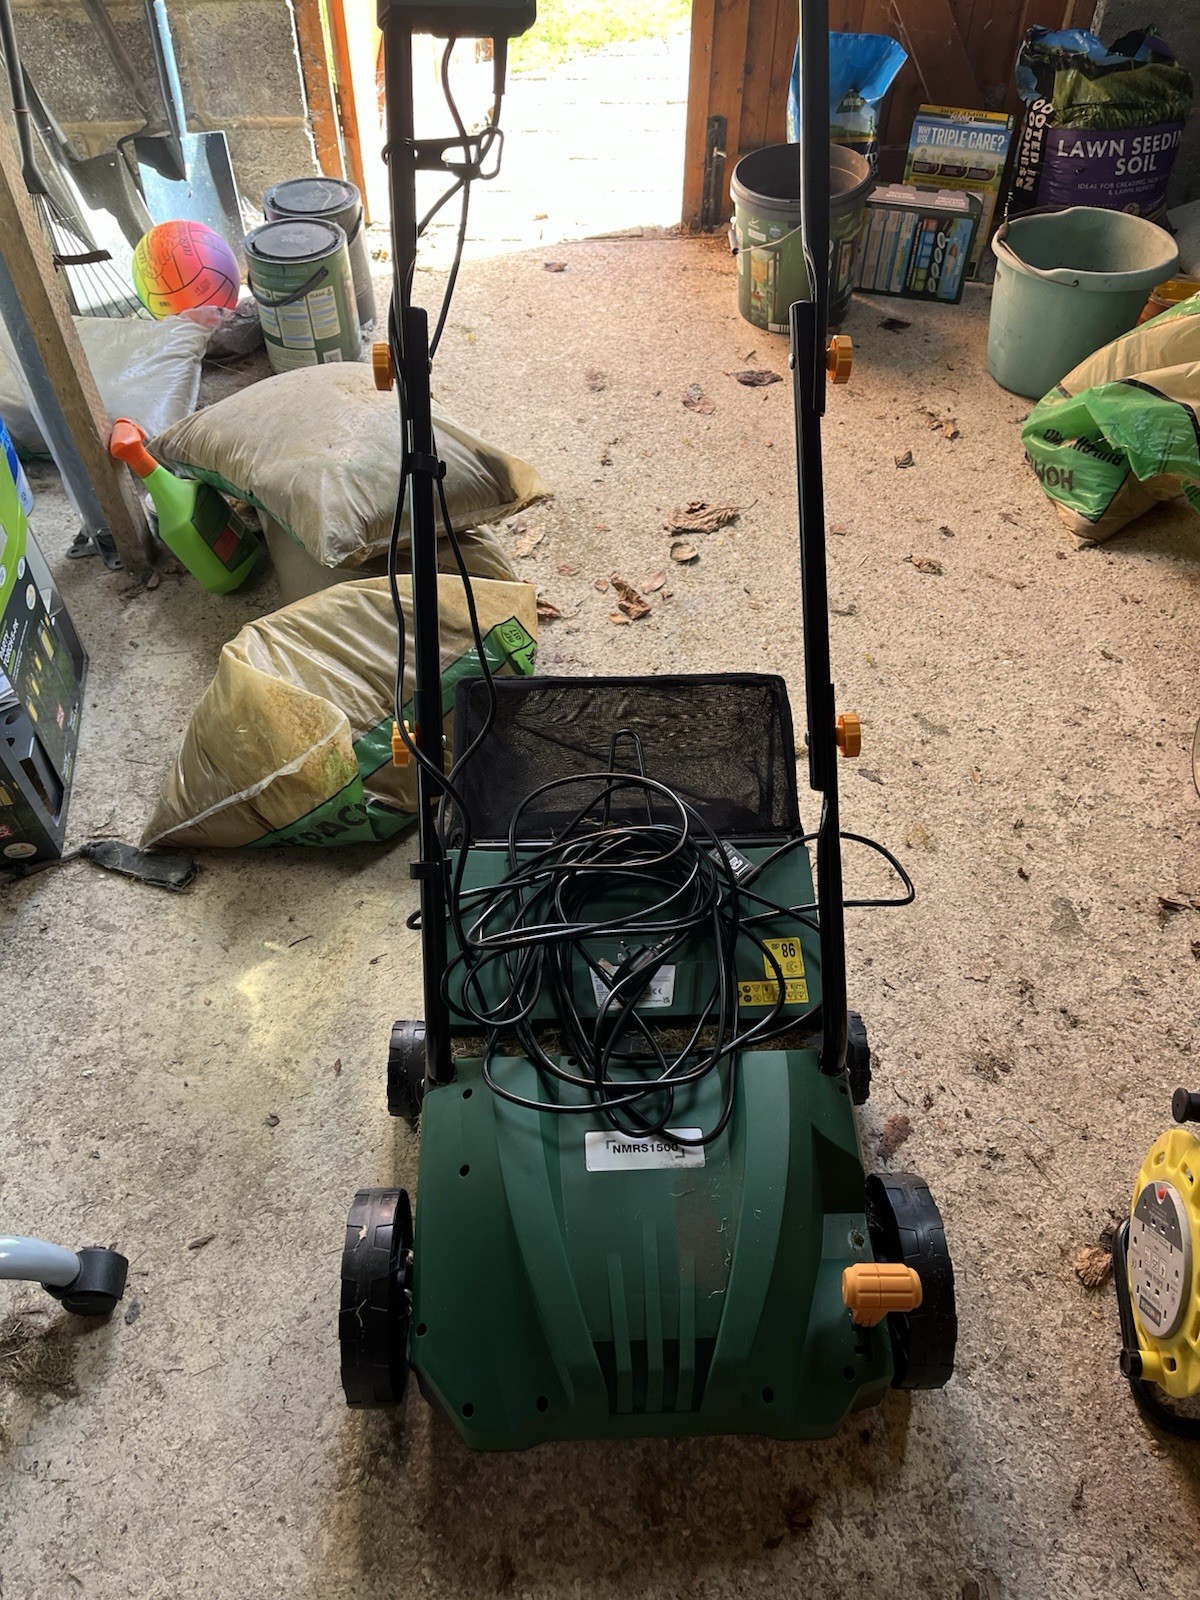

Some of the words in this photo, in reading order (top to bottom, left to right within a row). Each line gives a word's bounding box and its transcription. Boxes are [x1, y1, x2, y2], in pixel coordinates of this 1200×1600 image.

[918, 125, 931, 135] WHY
[917, 134, 928, 144] USE
[931, 127, 967, 148] TRIPLE
[968, 131, 1005, 152] CARE?
[1057, 139, 1126, 159] LAWN
[1114, 154, 1157, 176] SOIL
[612, 1143, 679, 1154] NMRS1500
